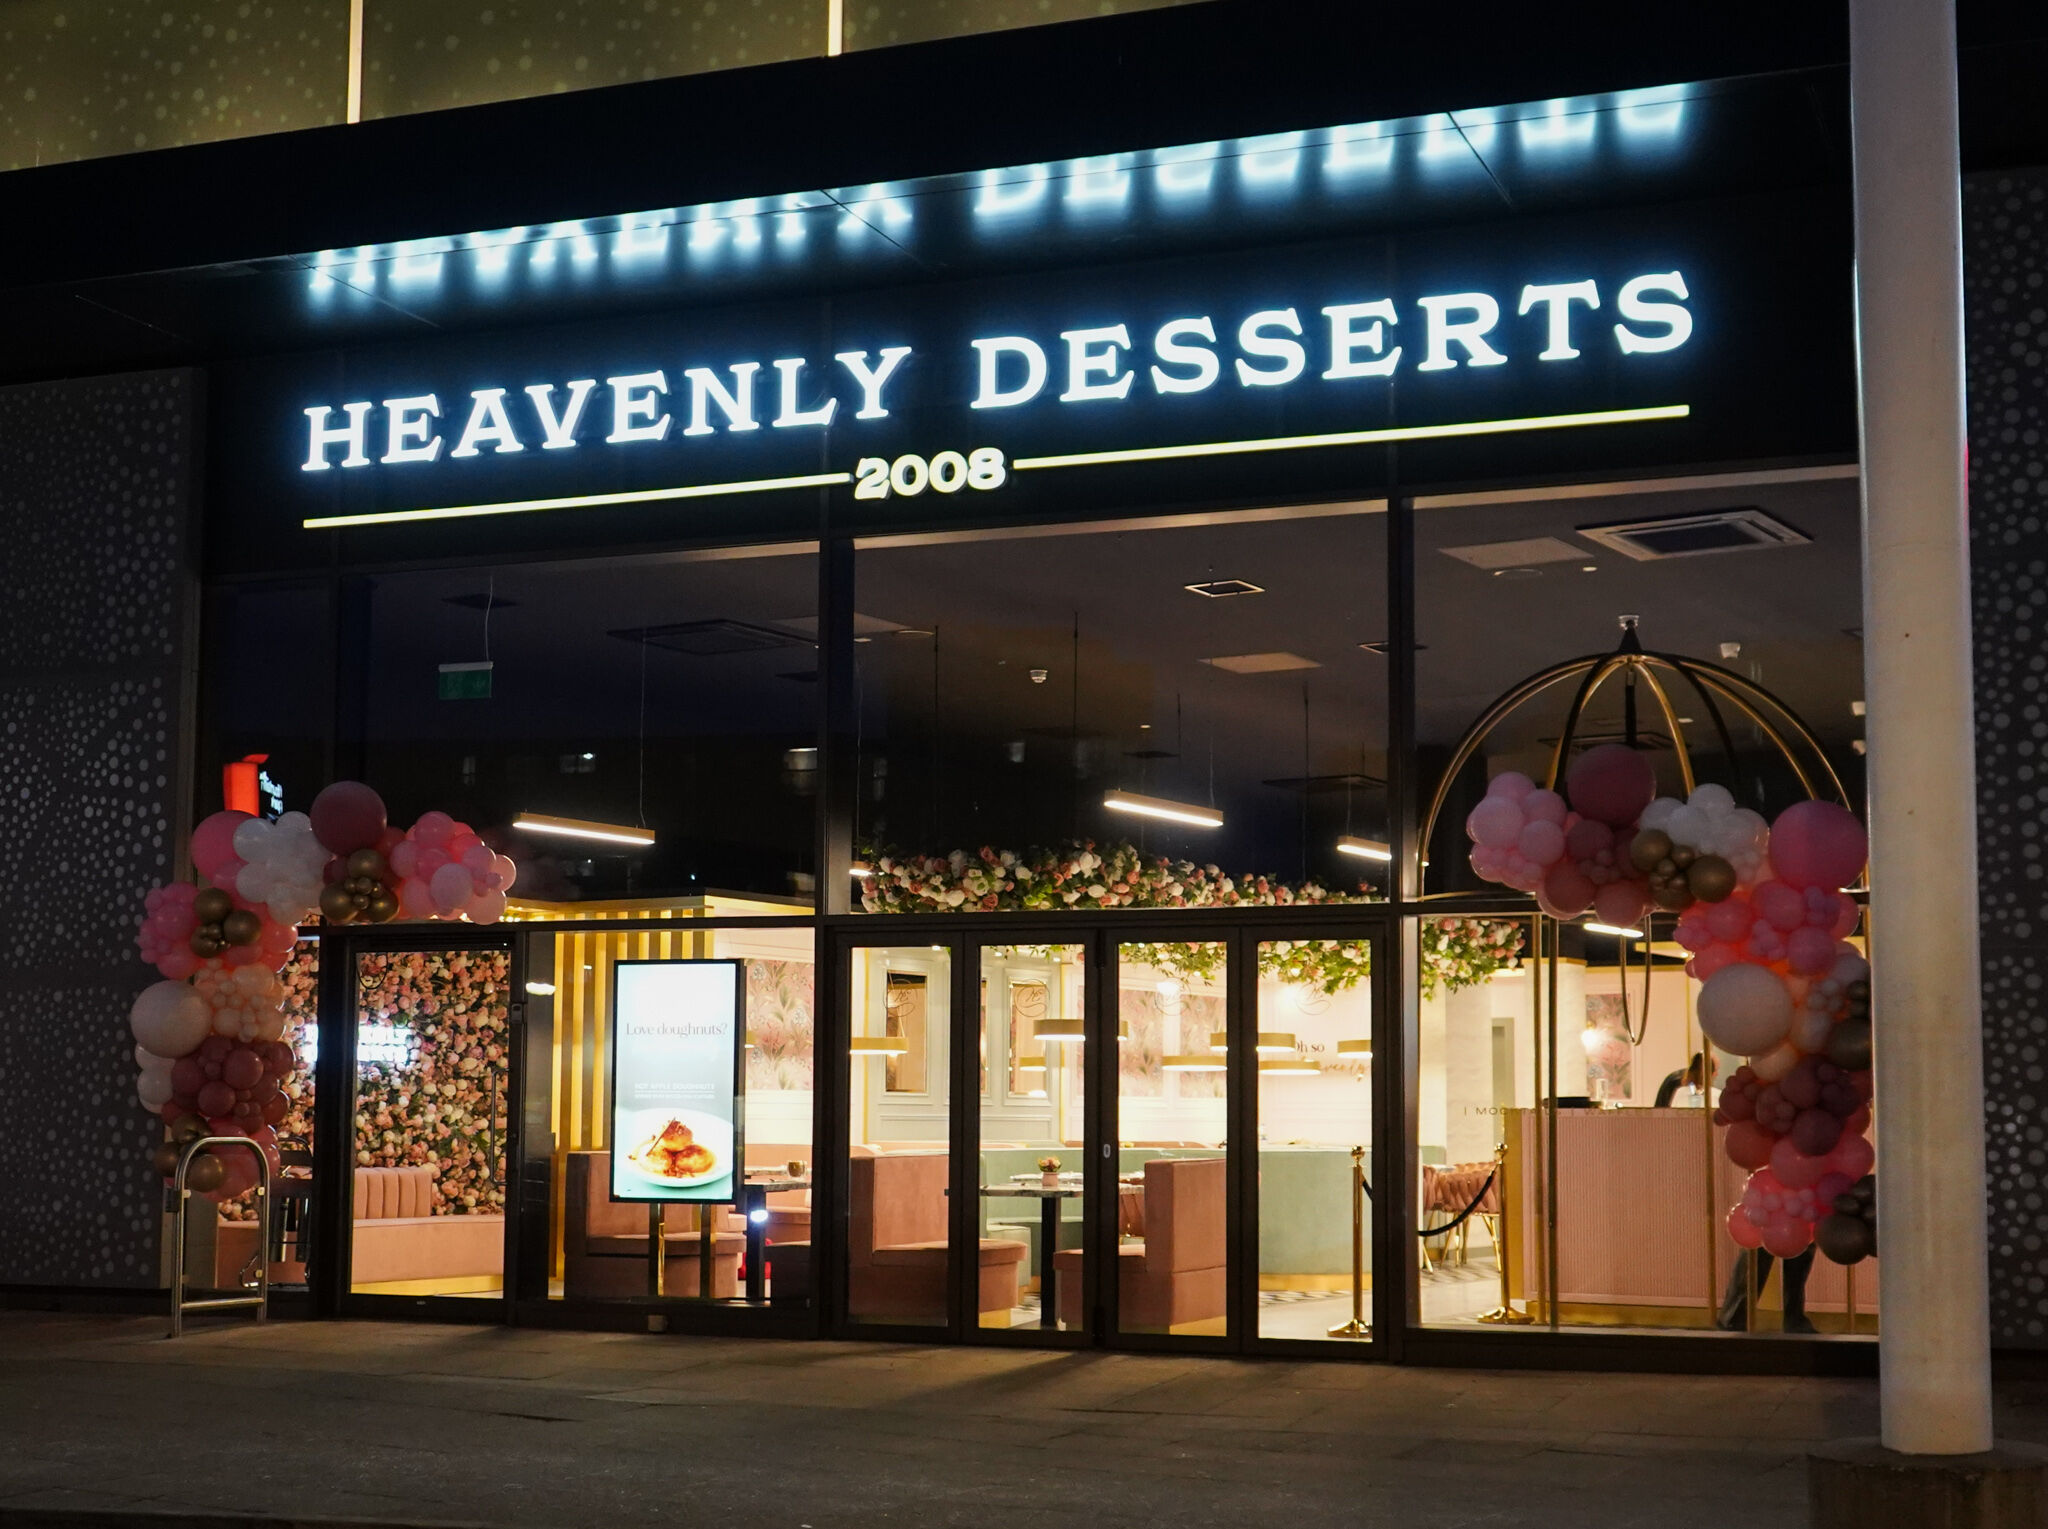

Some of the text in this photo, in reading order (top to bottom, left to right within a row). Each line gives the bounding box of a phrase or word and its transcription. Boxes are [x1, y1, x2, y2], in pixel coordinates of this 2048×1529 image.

[302, 271, 1692, 470] HEAVENLY DESSERTS
[855, 448, 1005, 499] 2008
[626, 1023, 728, 1038] Love doughnuts?
